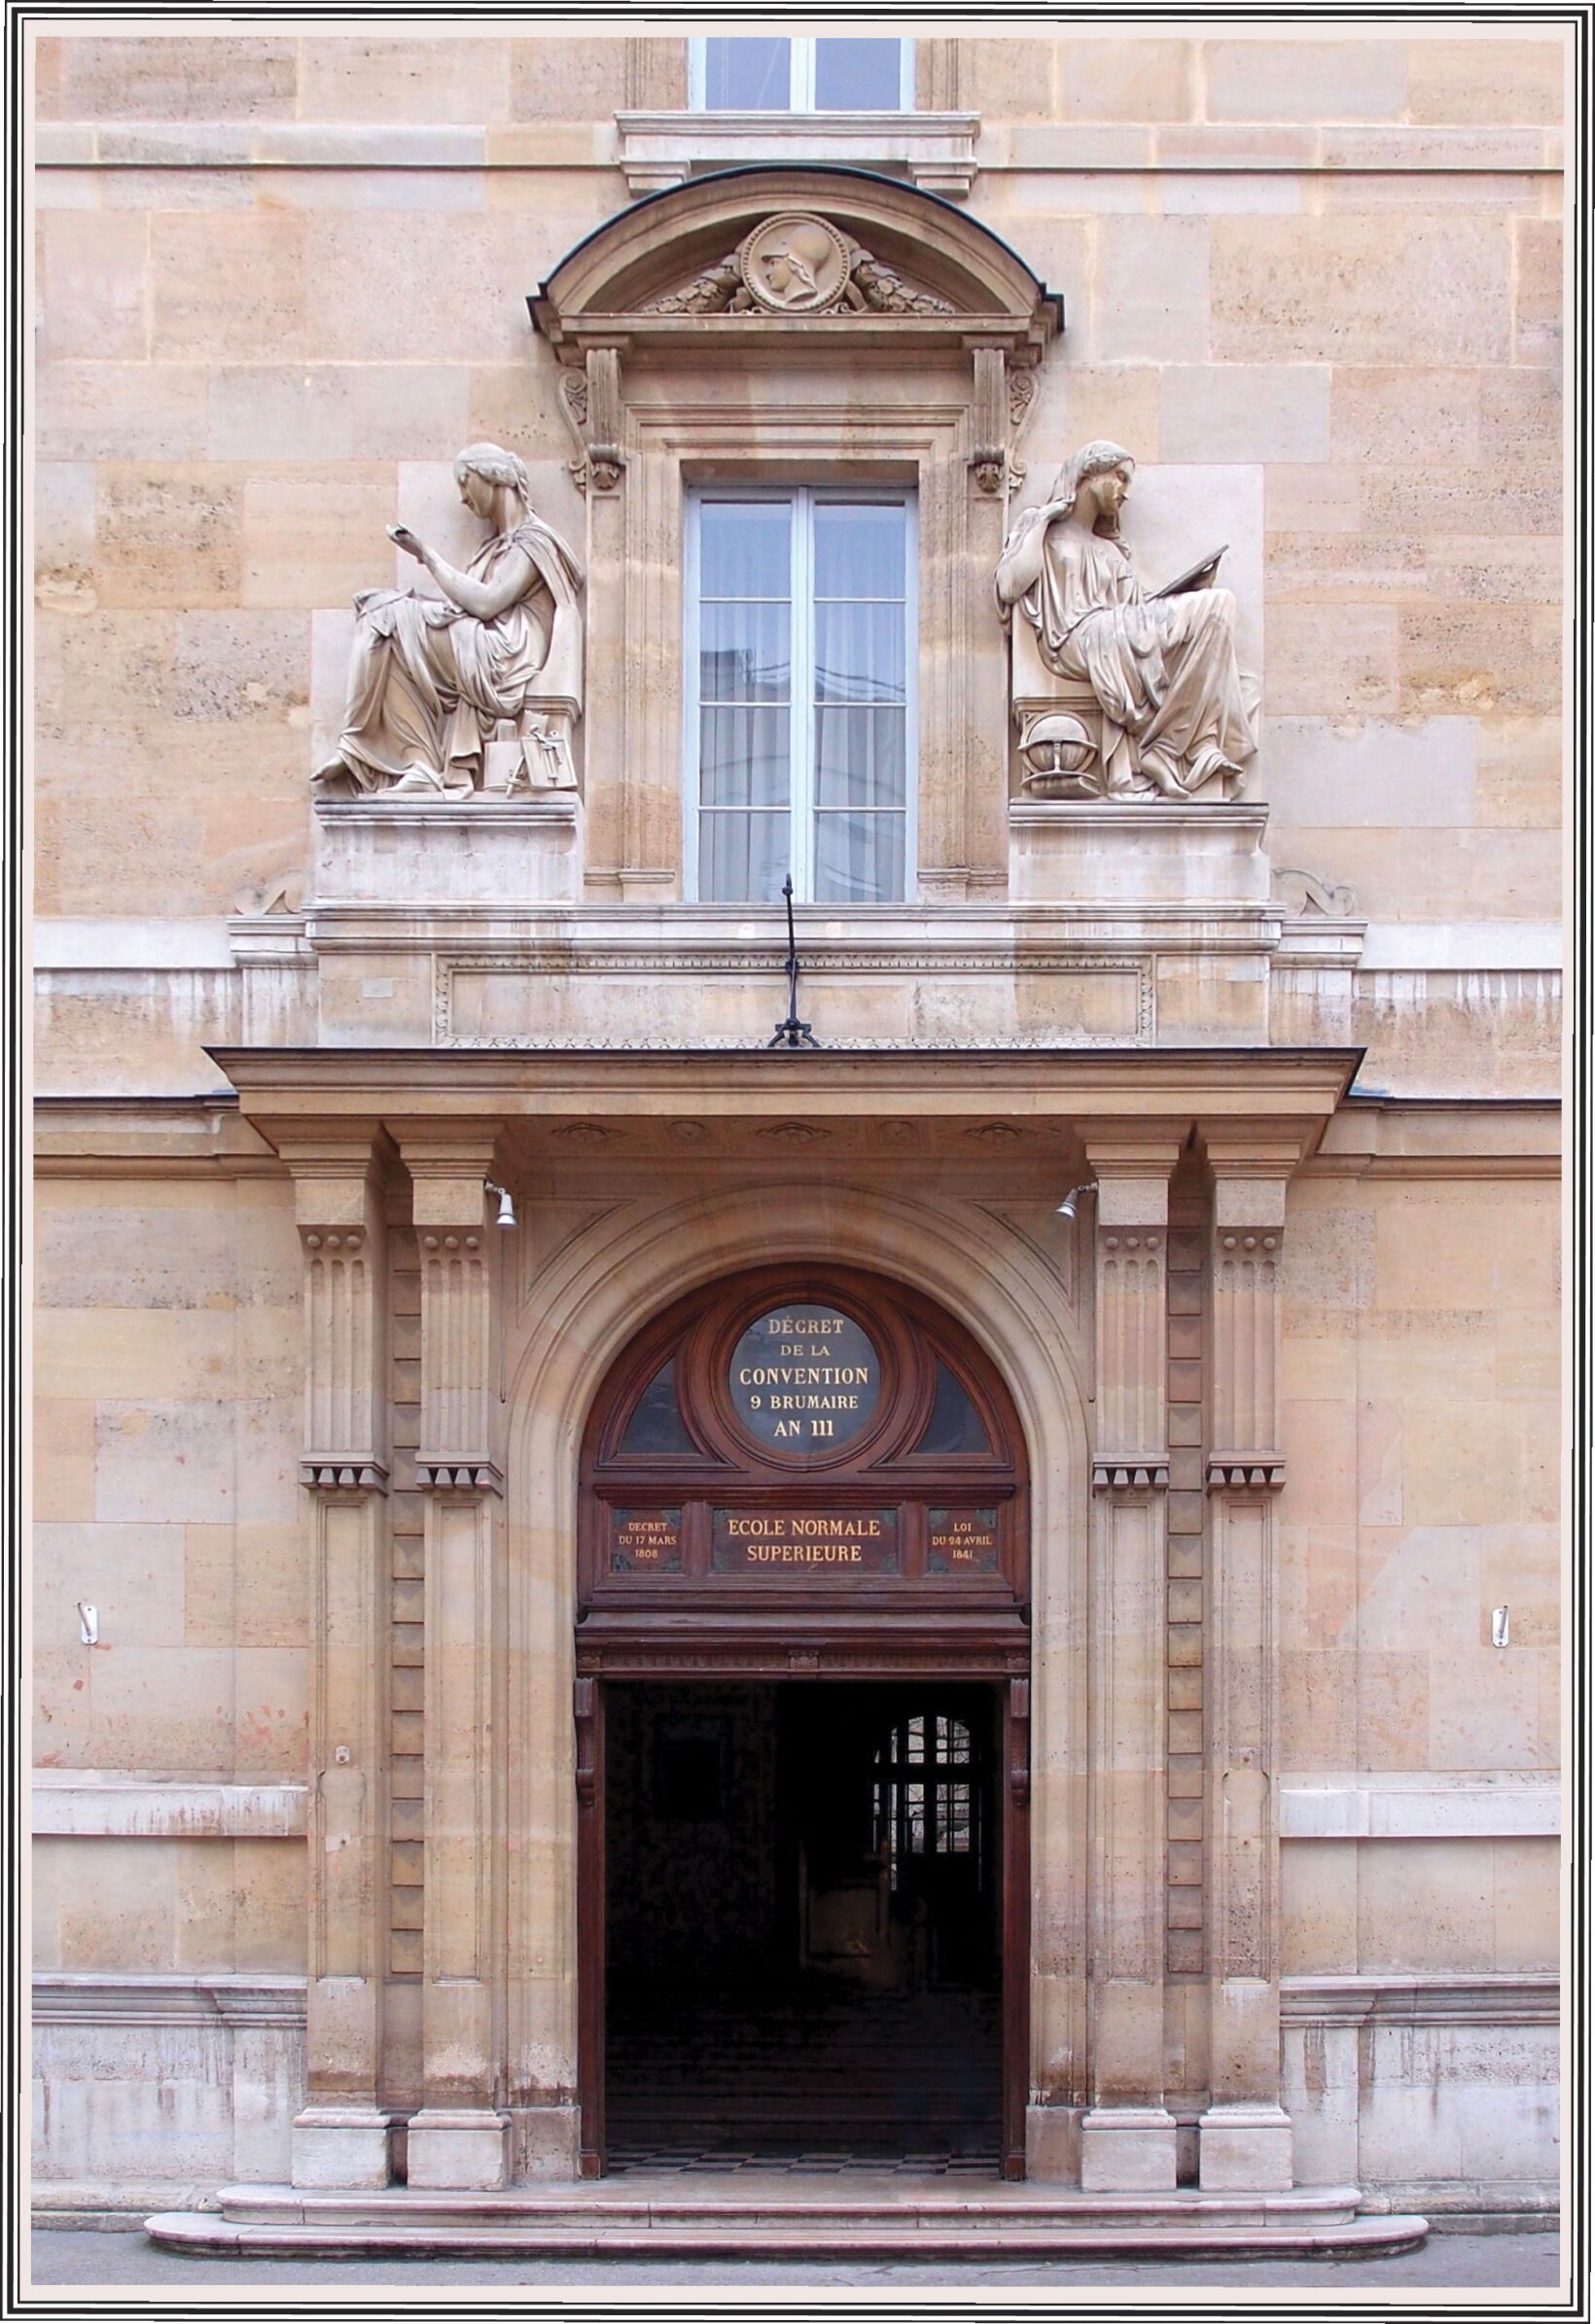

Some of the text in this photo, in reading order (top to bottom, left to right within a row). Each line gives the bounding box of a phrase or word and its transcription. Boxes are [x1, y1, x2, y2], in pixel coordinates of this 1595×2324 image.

[768, 1316, 844, 1334] DÉCRET
[781, 1345, 830, 1356] DE LA
[739, 1367, 868, 1385] CONVENTION
[750, 1395, 858, 1409] 9 BRUMAIRE
[774, 1420, 800, 1436] AN
[628, 1522, 668, 1532] DECRET
[728, 1520, 880, 1535] ECOLE NORMALE
[953, 1523, 972, 1532] LOI
[619, 1535, 677, 1545] DU 17 MARS
[933, 1536, 946, 1546] DU
[964, 1536, 993, 1546] AVRIL
[747, 1545, 862, 1562] SUPERIEURE
